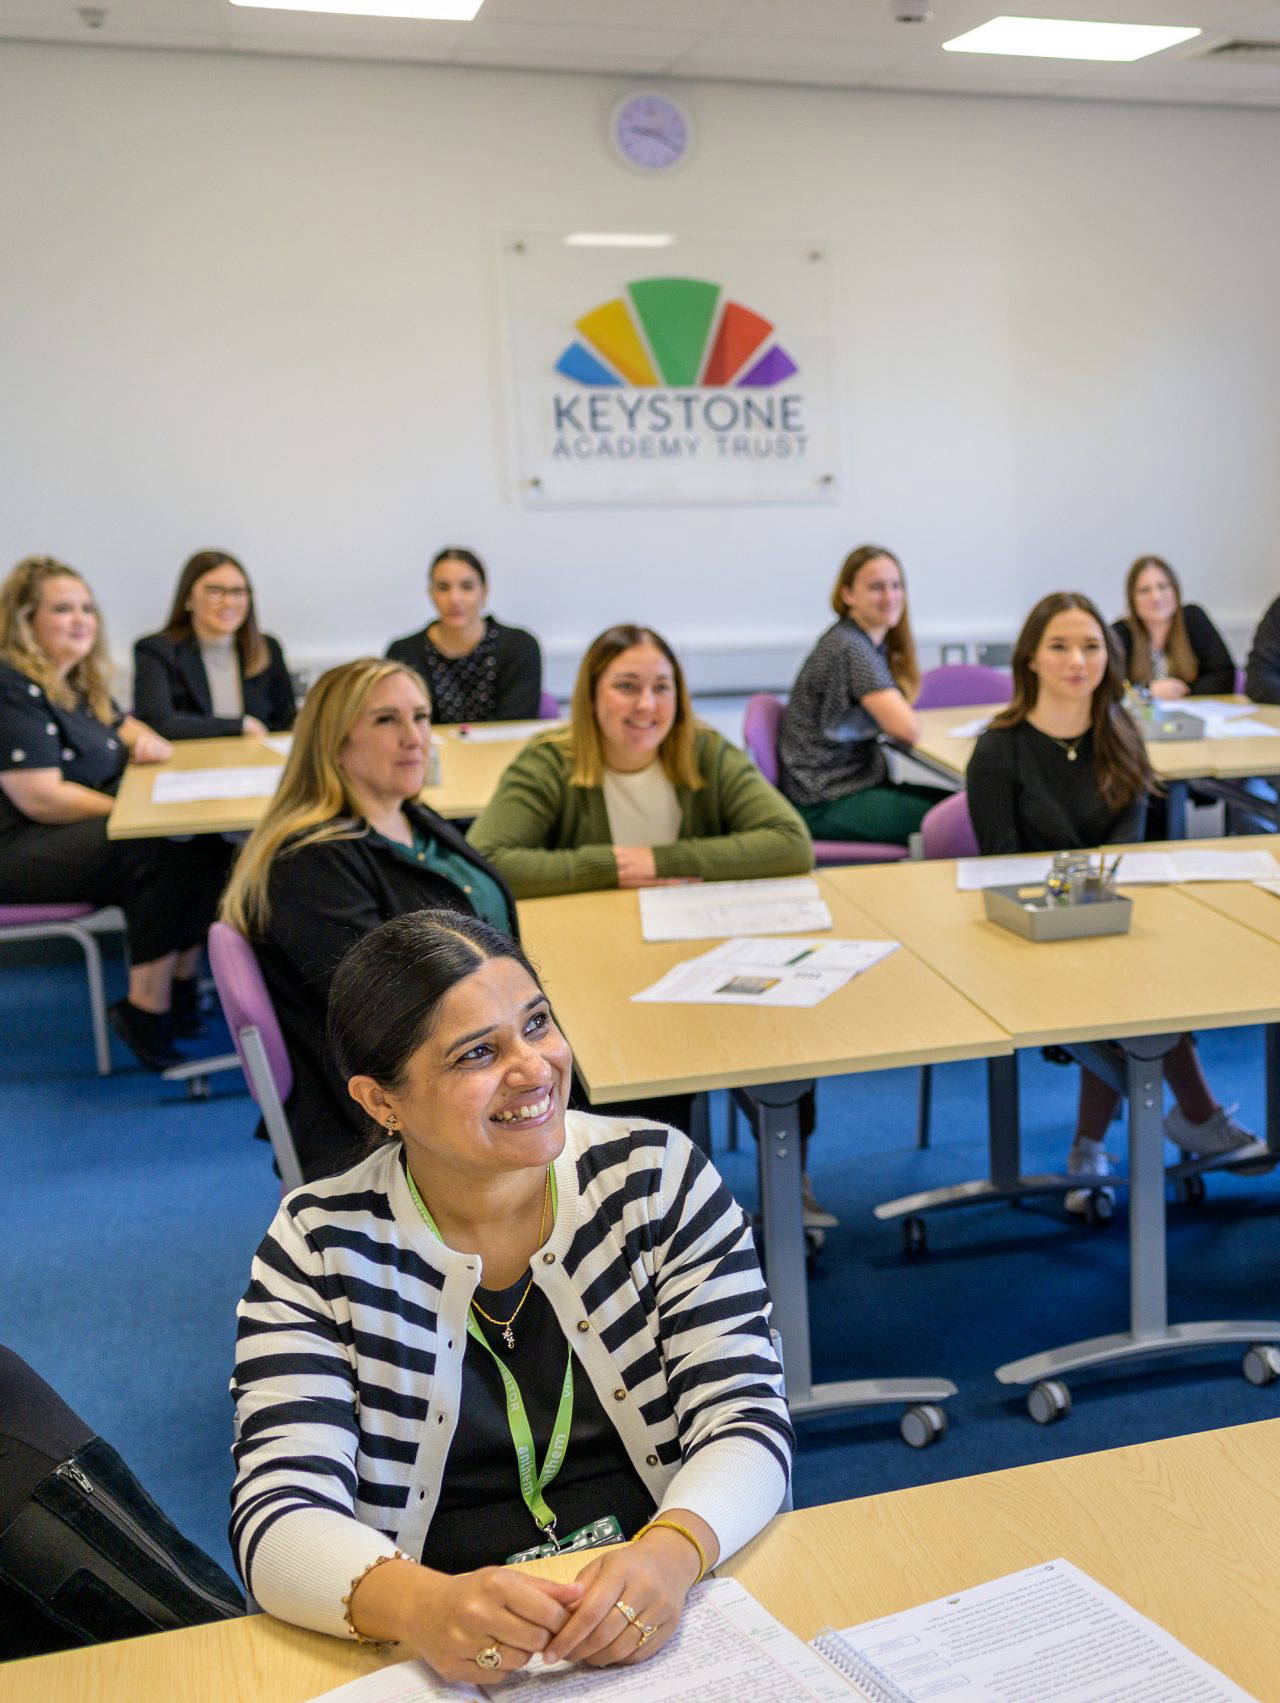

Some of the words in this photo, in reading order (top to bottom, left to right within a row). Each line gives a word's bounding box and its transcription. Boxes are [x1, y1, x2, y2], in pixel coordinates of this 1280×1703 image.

[553, 394, 806, 432] KEYSTONE
[552, 435, 698, 459] ACADEMY
[717, 435, 809, 458] TRUST
[518, 1445, 533, 1496] anthem
